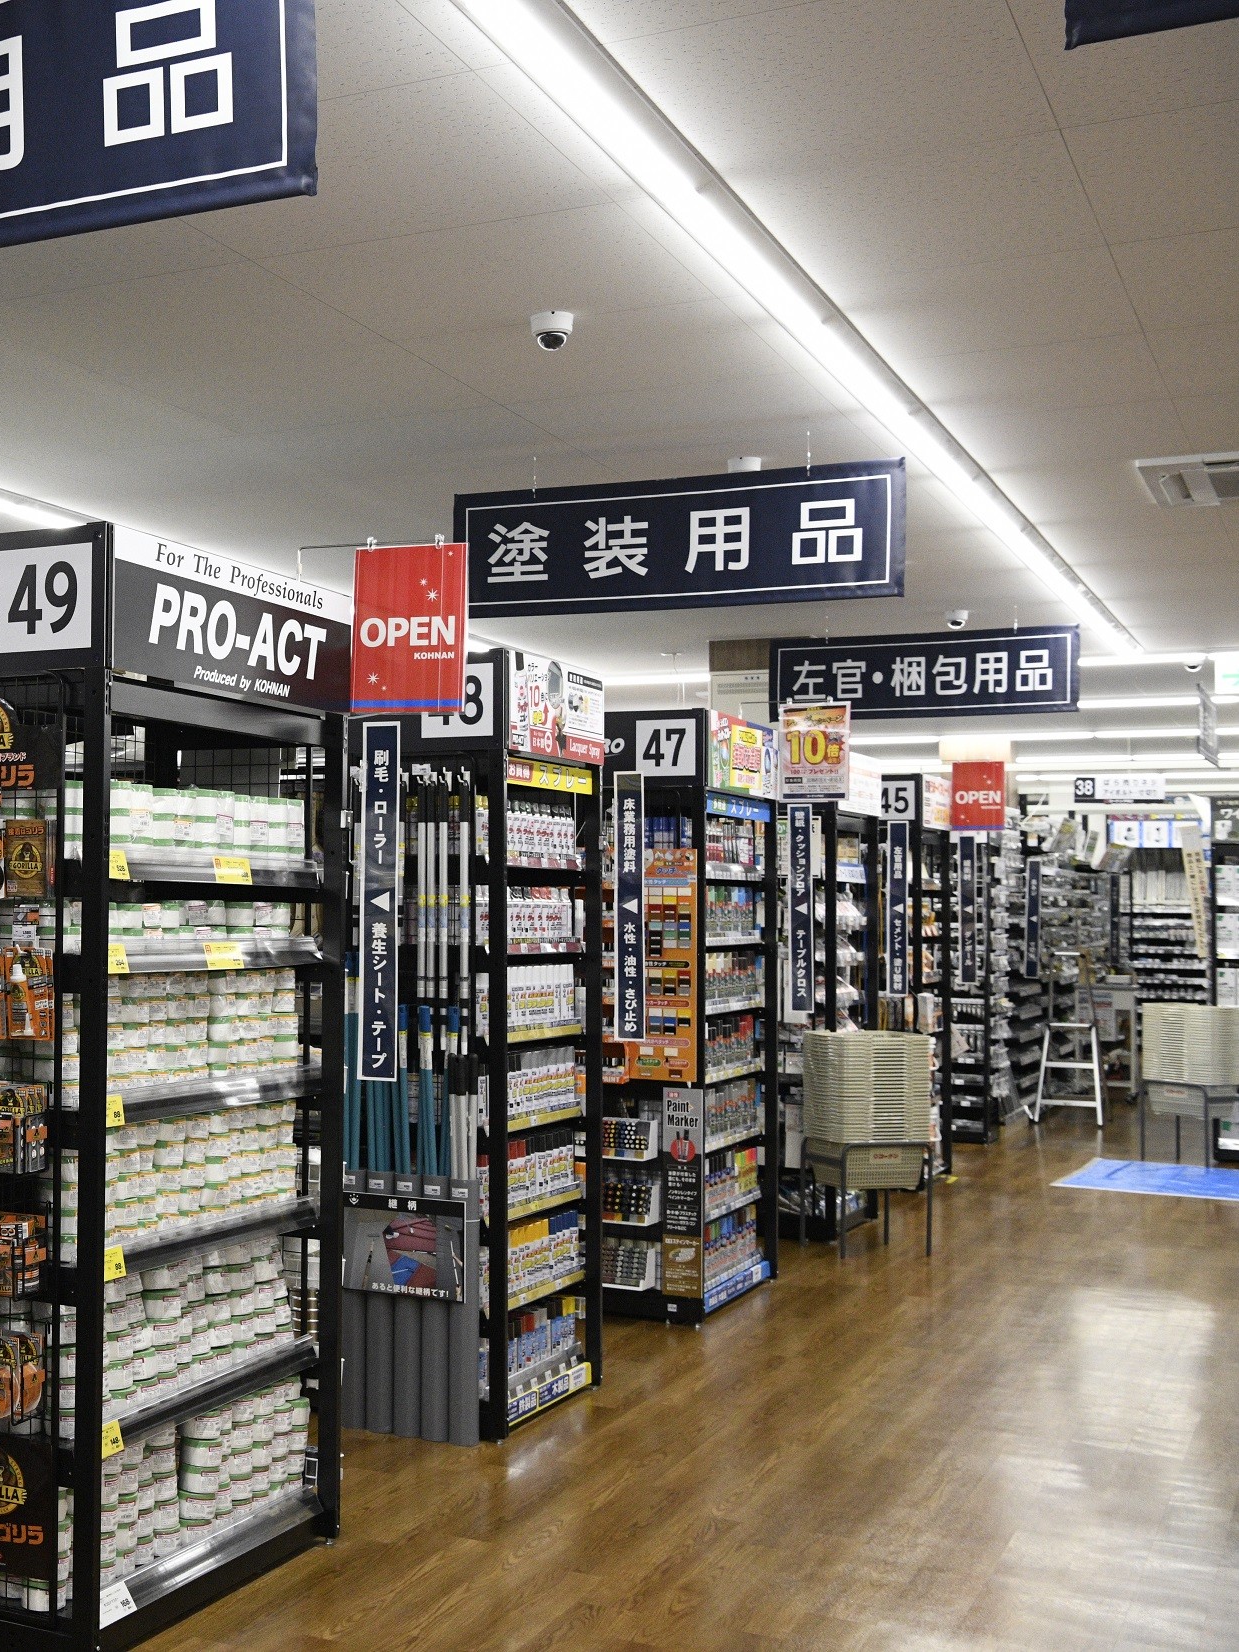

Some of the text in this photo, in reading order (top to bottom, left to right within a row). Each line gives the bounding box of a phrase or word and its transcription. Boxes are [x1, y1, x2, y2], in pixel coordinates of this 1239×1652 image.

[487, 498, 862, 584] 塗装用品
[155, 542, 324, 610] For The Professionals
[7, 560, 79, 636] 49
[148, 582, 327, 680] PRO-ACT
[359, 615, 455, 648] OPEN
[413, 651, 455, 660] KOHNAN
[193, 665, 290, 698] Produced by KOHNAN
[792, 650, 1053, 700] 左官・梱包用品
[569, 738, 601, 760] Lacquer Spray
[642, 728, 687, 767] 47
[786, 729, 826, 765] 10
[539, 765, 587, 788] スプレー
[1075, 780, 1094, 795] 38
[372, 749, 390, 866] 刷毛・ローラー
[731, 800, 760, 817] スプレー
[881, 787, 909, 814] 45
[955, 790, 1001, 804] OPEN
[622, 797, 636, 874] 床業務用塗料
[12, 862, 39, 870] GORILLA
[623, 922, 637, 1033] 水性・油性・さび止め
[371, 921, 388, 1070] 養生シート・テープ
[667, 1100, 690, 1112] Paint
[667, 1114, 698, 1128] Marker
